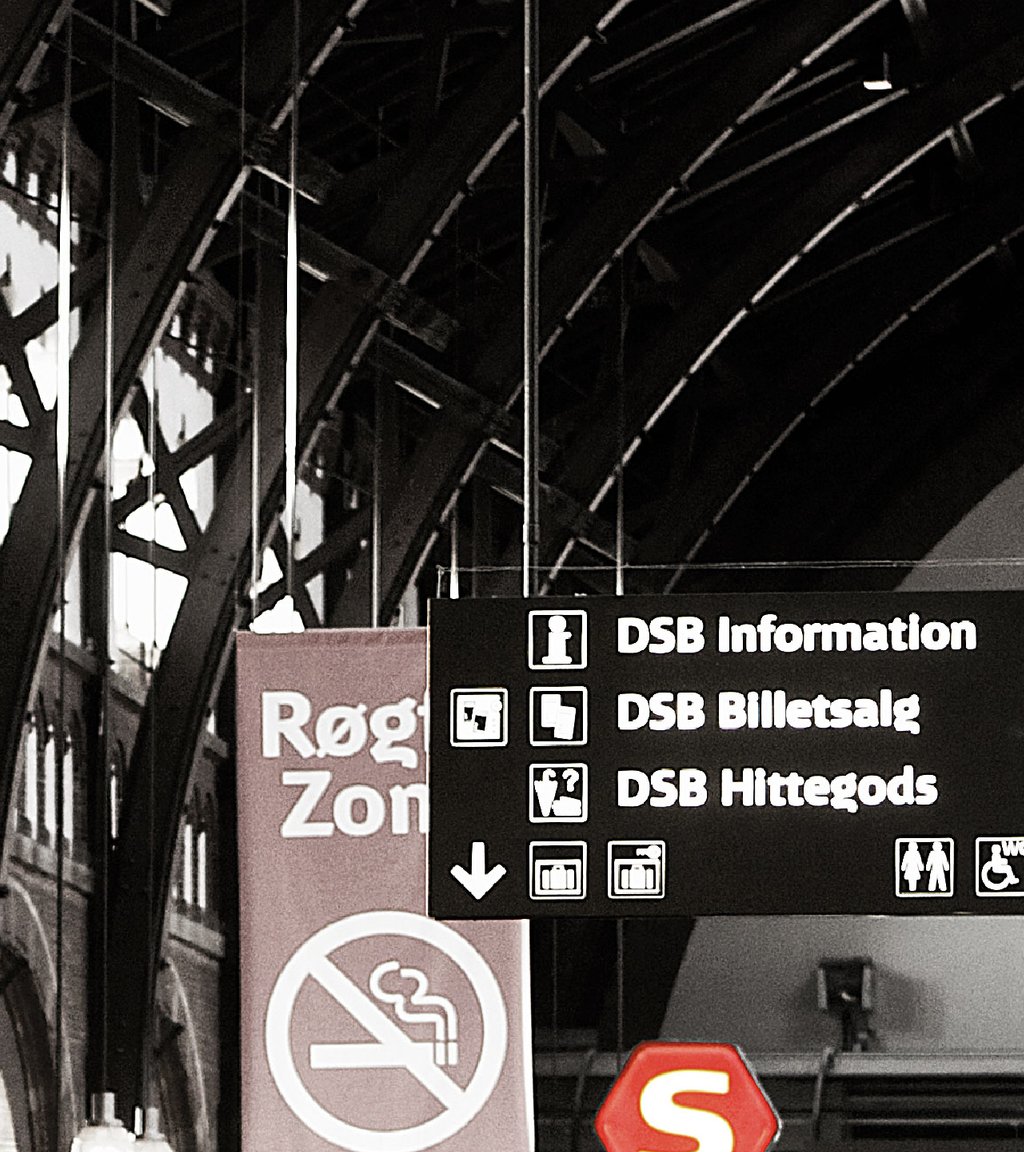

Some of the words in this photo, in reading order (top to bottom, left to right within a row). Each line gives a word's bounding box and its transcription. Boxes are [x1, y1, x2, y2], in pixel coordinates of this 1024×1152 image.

[617, 616, 705, 654] DSB
[718, 612, 978, 653] Information
[617, 692, 706, 731] DSB
[718, 688, 921, 735] Billetsalg
[617, 768, 708, 808] DSB
[720, 764, 939, 814] Hittegods
